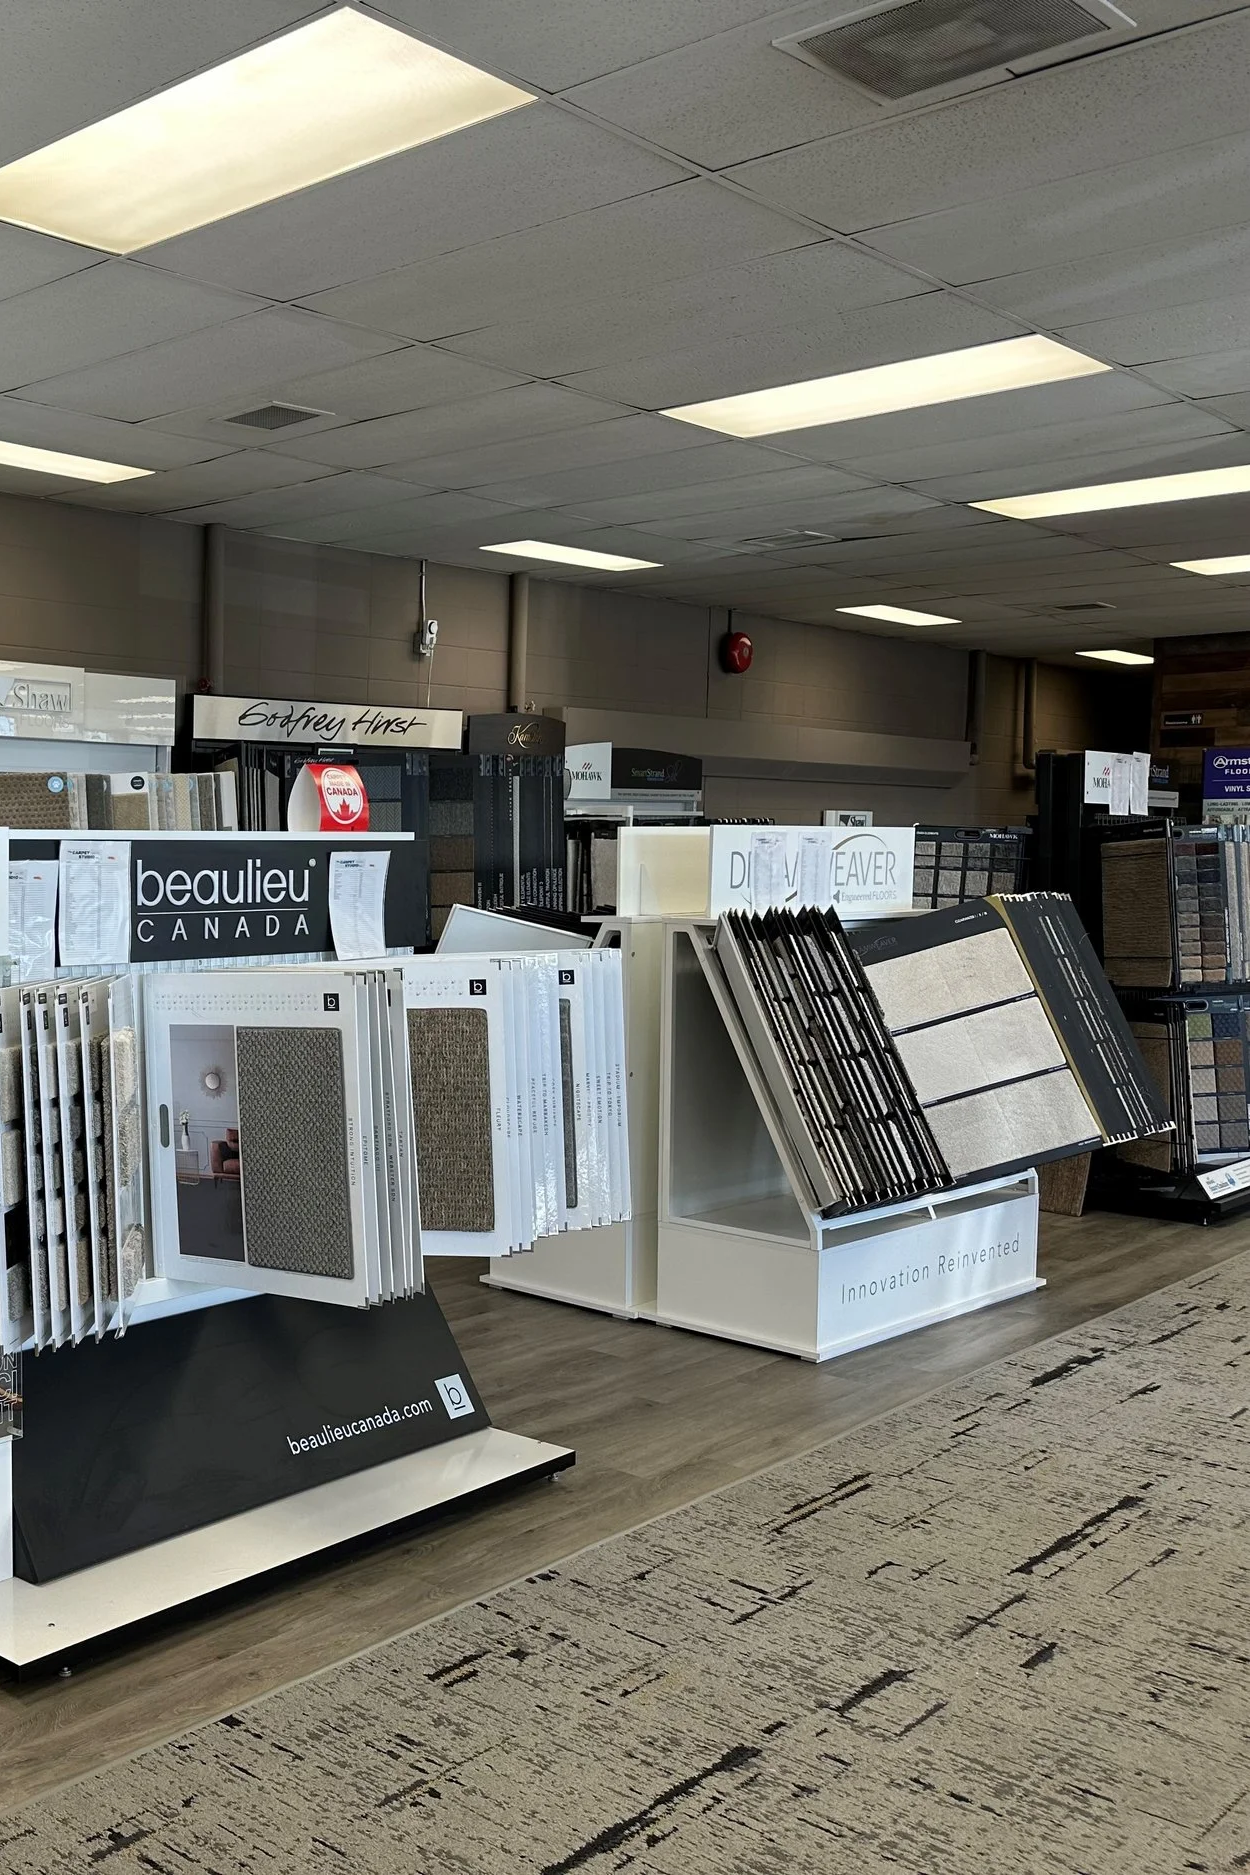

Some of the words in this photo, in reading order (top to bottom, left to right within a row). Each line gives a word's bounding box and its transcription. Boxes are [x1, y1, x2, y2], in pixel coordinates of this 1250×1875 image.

[13, 683, 68, 711] Shaw
[238, 702, 346, 741] Godfrey
[352, 709, 427, 735] Hirst
[571, 771, 602, 781] MOHAWK
[631, 767, 665, 778] SmartStrand
[1150, 765, 1169, 778] tStrand
[326, 787, 359, 796] CANADA
[1093, 778, 1111, 788] MOHA
[136, 859, 310, 907] beaulieu
[841, 892, 871, 904] Engineered
[872, 890, 897, 900] FLOORS
[137, 914, 310, 942] CANADA
[842, 1264, 929, 1304] Innovation
[938, 1233, 1020, 1276] Reinvented
[286, 1399, 433, 1456] beaulieucanada.com
